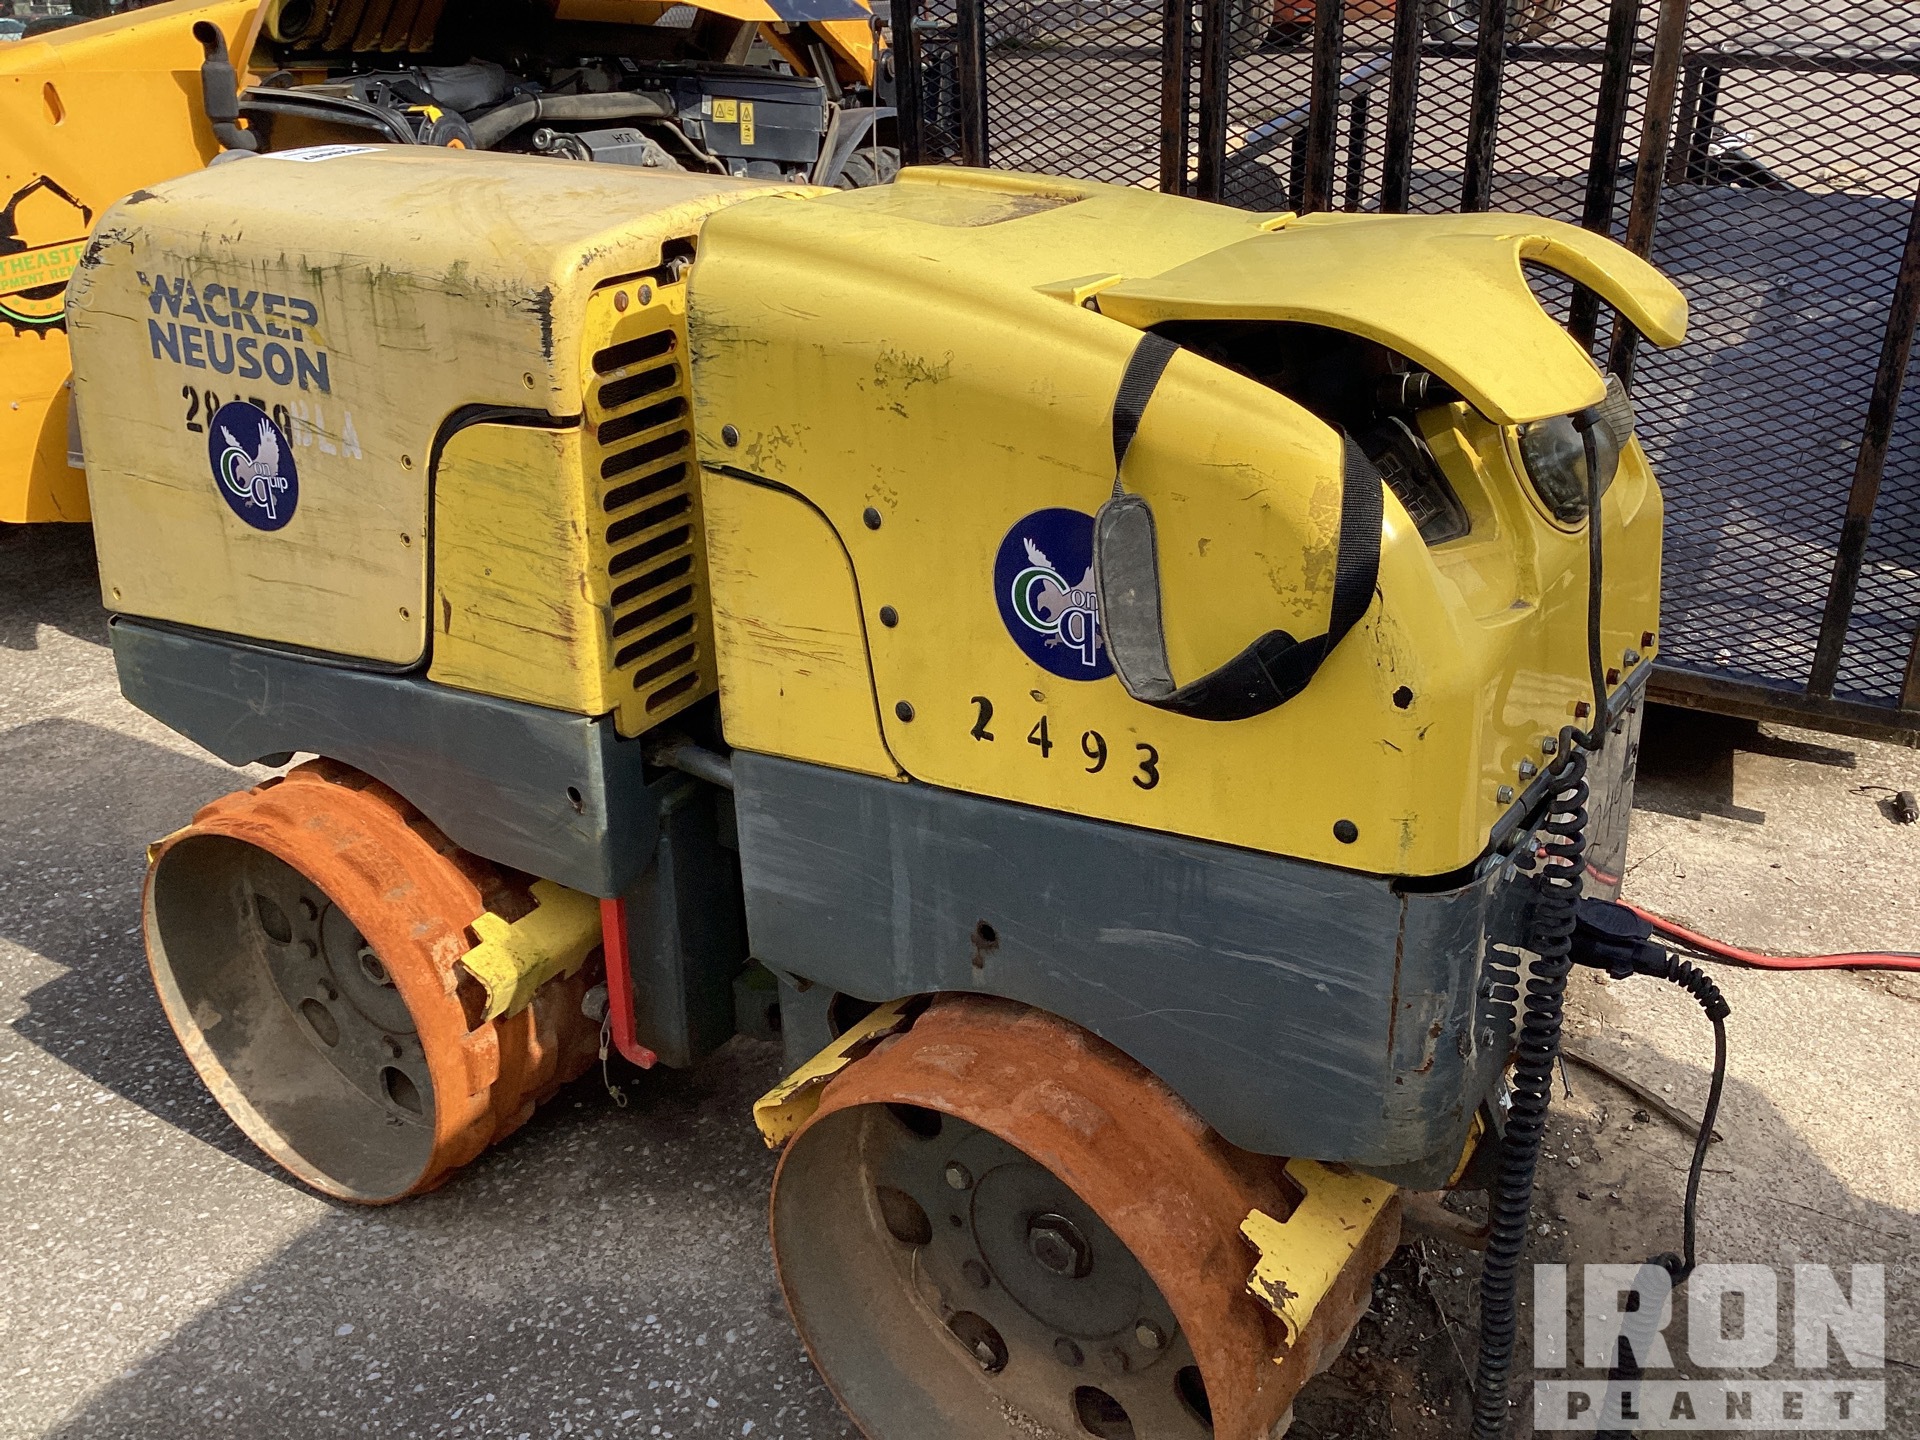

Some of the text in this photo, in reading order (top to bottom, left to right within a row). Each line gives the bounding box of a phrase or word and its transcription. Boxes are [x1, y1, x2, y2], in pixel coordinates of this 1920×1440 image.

[136, 271, 319, 343] WACKER
[148, 318, 331, 395] NEUSON
[970, 696, 1160, 791] 2493
